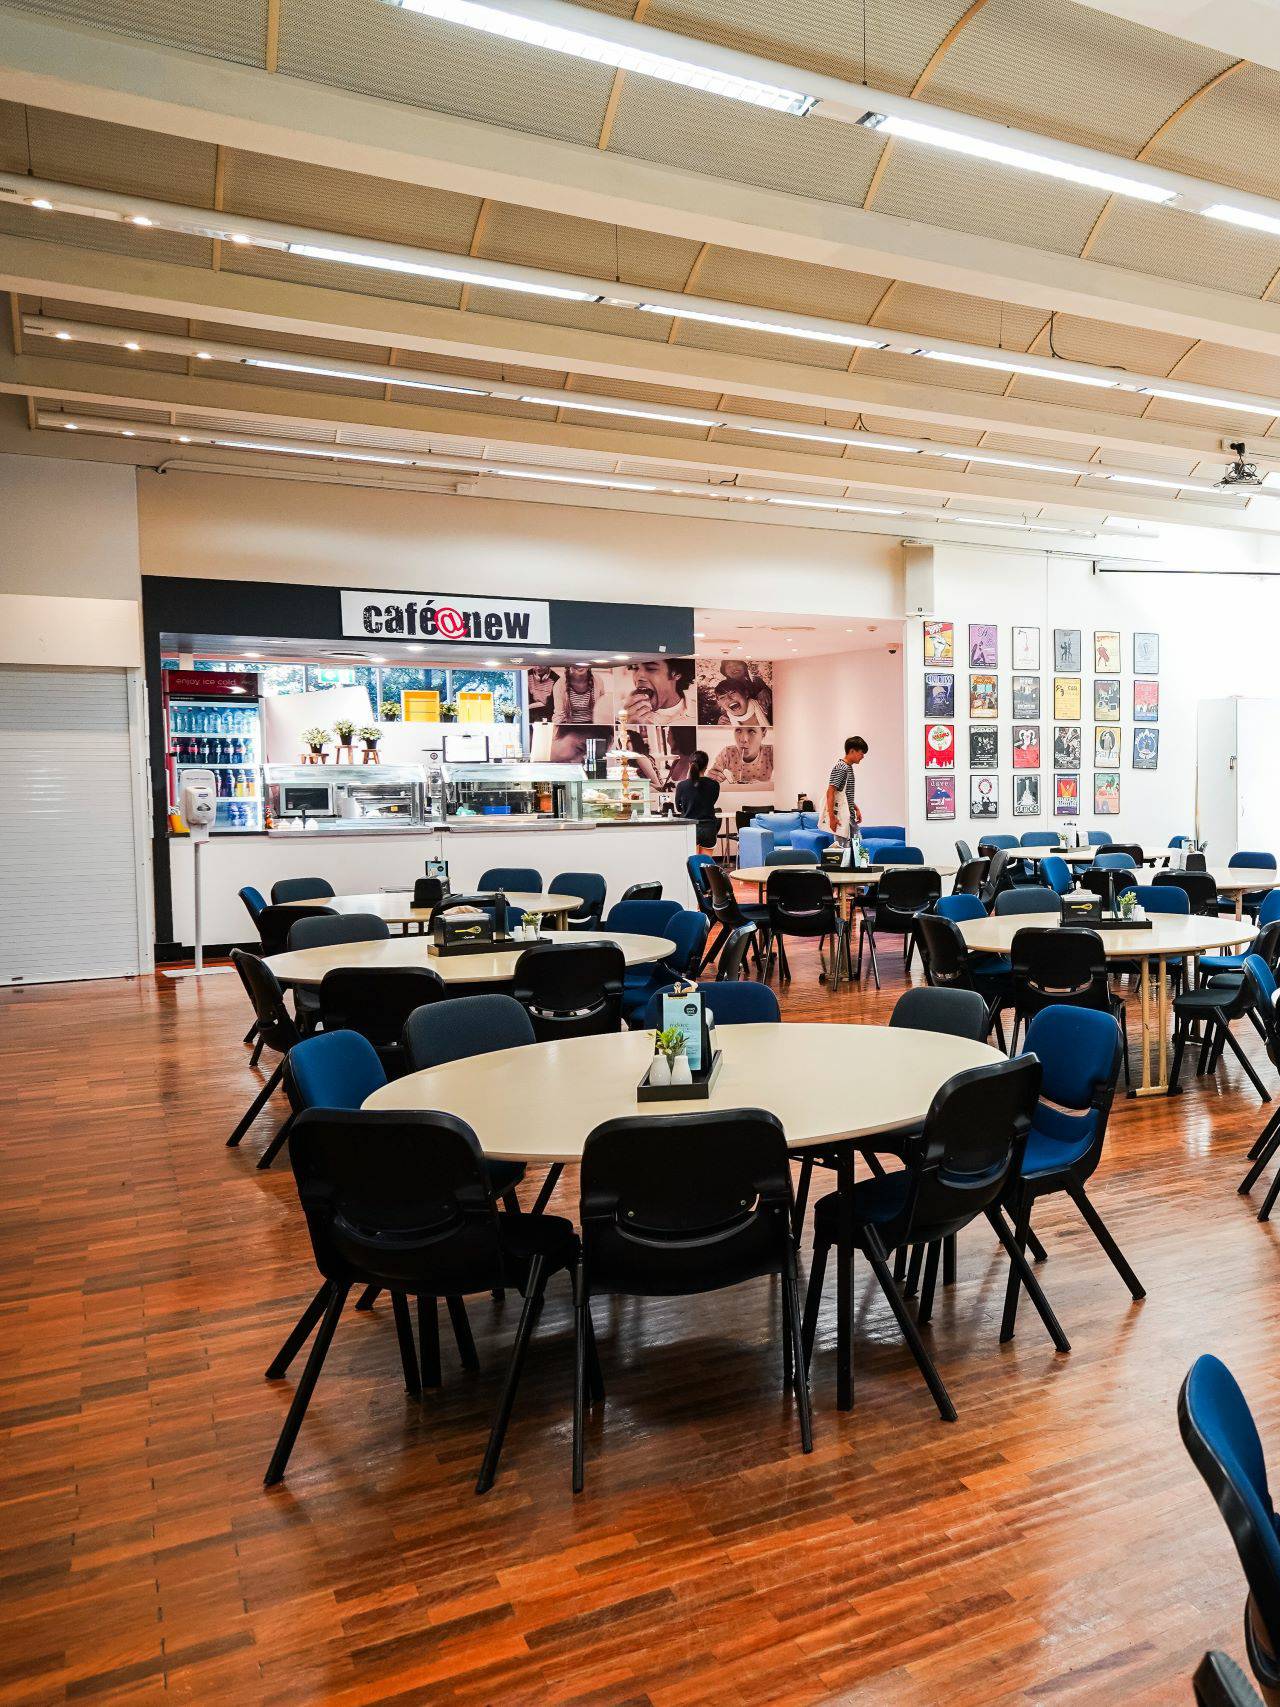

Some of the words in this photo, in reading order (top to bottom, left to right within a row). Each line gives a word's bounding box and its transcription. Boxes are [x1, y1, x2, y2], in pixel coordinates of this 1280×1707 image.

[362, 599, 531, 641] café@new
[175, 678, 200, 686] enjoy
[202, 678, 215, 686] ice
